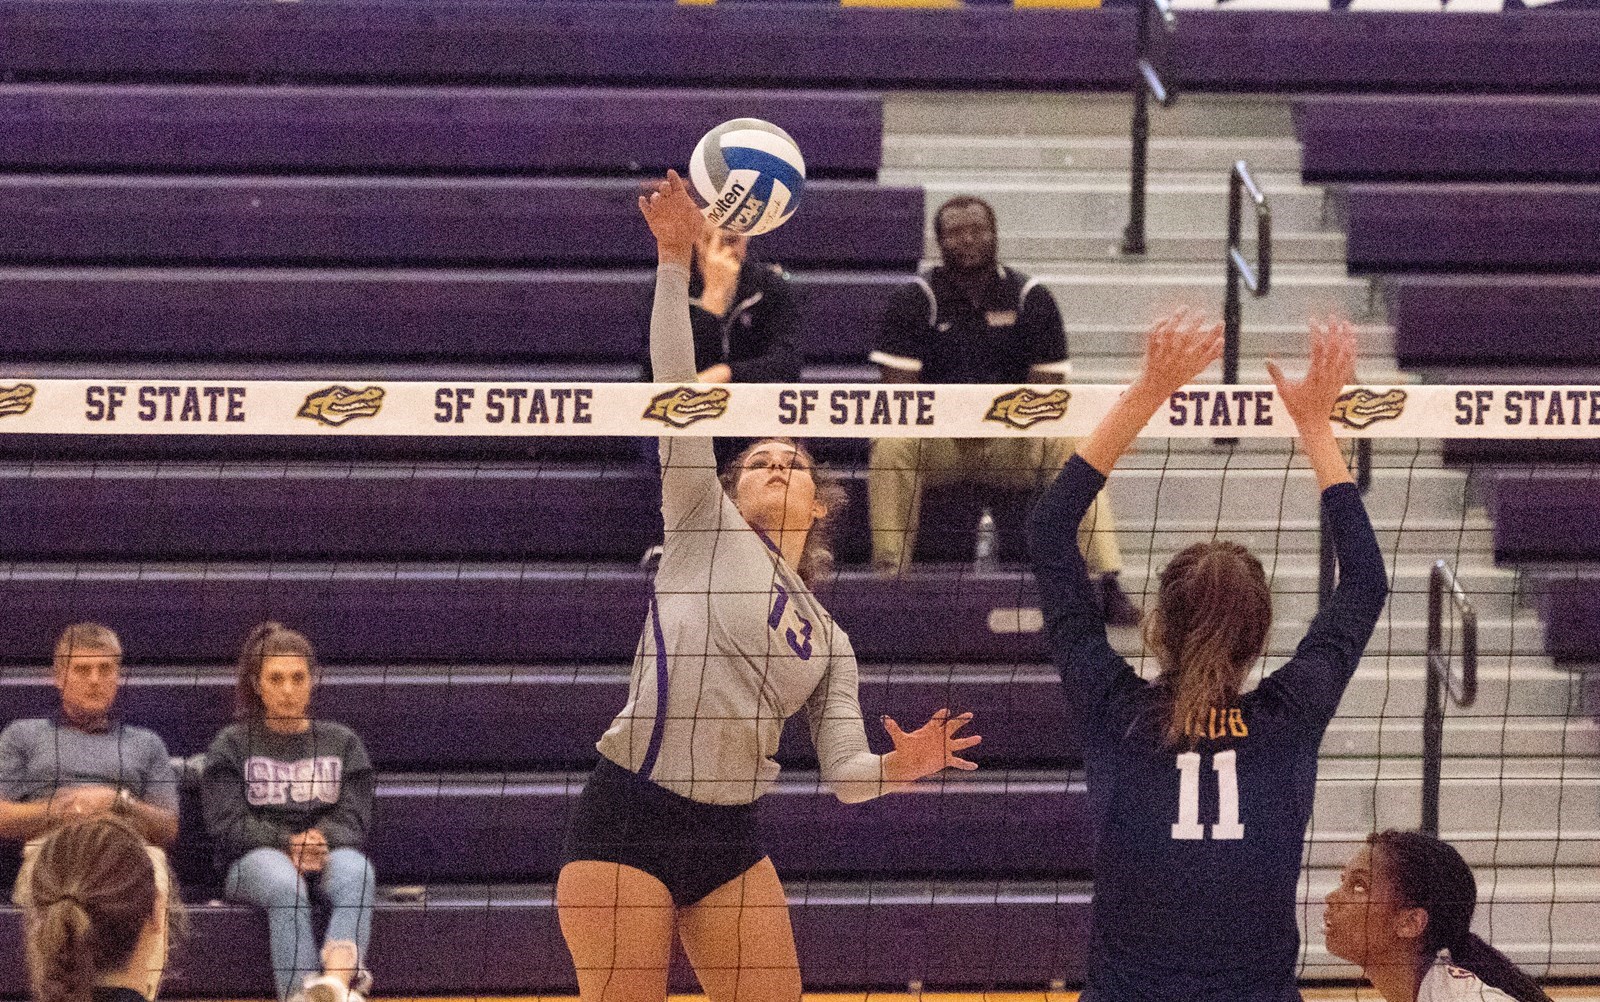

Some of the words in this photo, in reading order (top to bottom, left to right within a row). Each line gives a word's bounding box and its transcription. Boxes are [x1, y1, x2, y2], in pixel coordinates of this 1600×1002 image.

[706, 182, 745, 224] molten
[85, 385, 127, 422] SF
[138, 386, 246, 422] STATE
[434, 387, 475, 424] SF
[485, 388, 593, 424] STATE
[778, 389, 819, 425] SF
[830, 390, 936, 425] STATE
[1169, 390, 1273, 426] STATE
[1455, 390, 1494, 425] SF
[1504, 390, 1600, 425] STATE
[1171, 749, 1245, 840] 11
